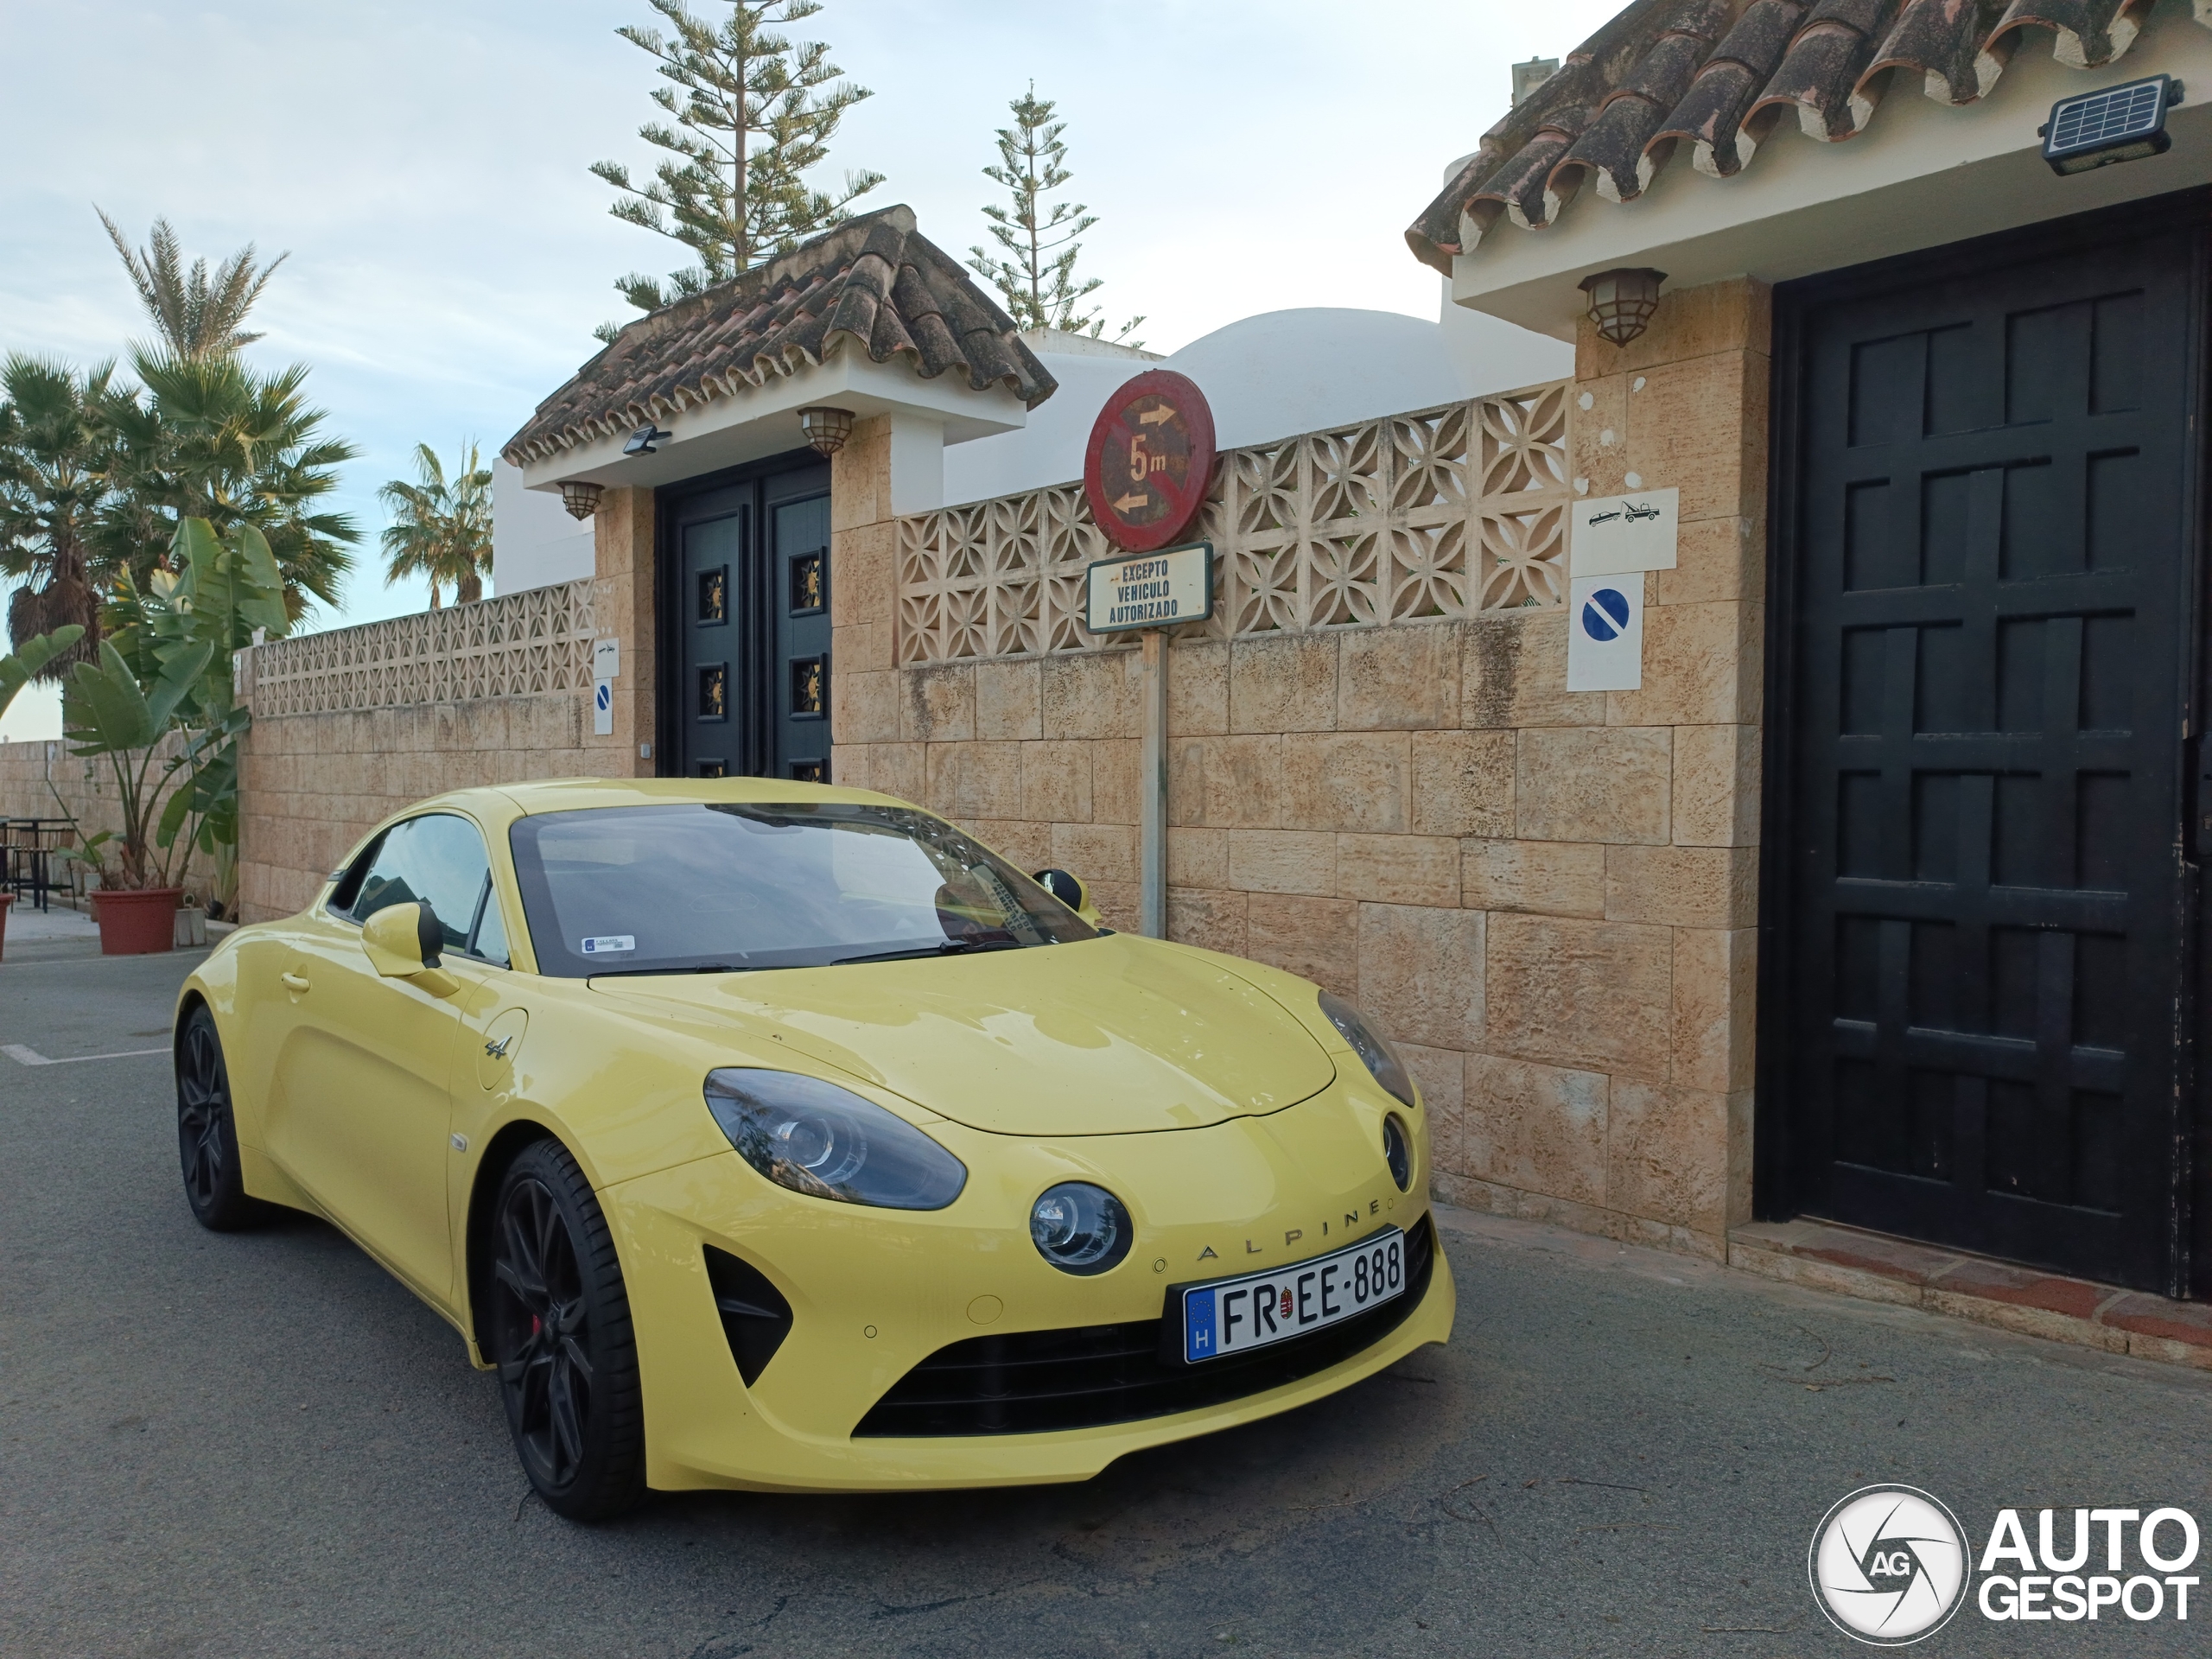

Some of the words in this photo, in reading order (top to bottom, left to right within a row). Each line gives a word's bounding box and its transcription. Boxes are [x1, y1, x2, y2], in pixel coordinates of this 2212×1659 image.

[1122, 559, 1168, 582] EXCEPTO
[1118, 580, 1170, 602] VEHICULO
[1109, 599, 1178, 624] AUTORIZADO
[1197, 1199, 1379, 1261] ALPINE
[1196, 1329, 1209, 1349] H
